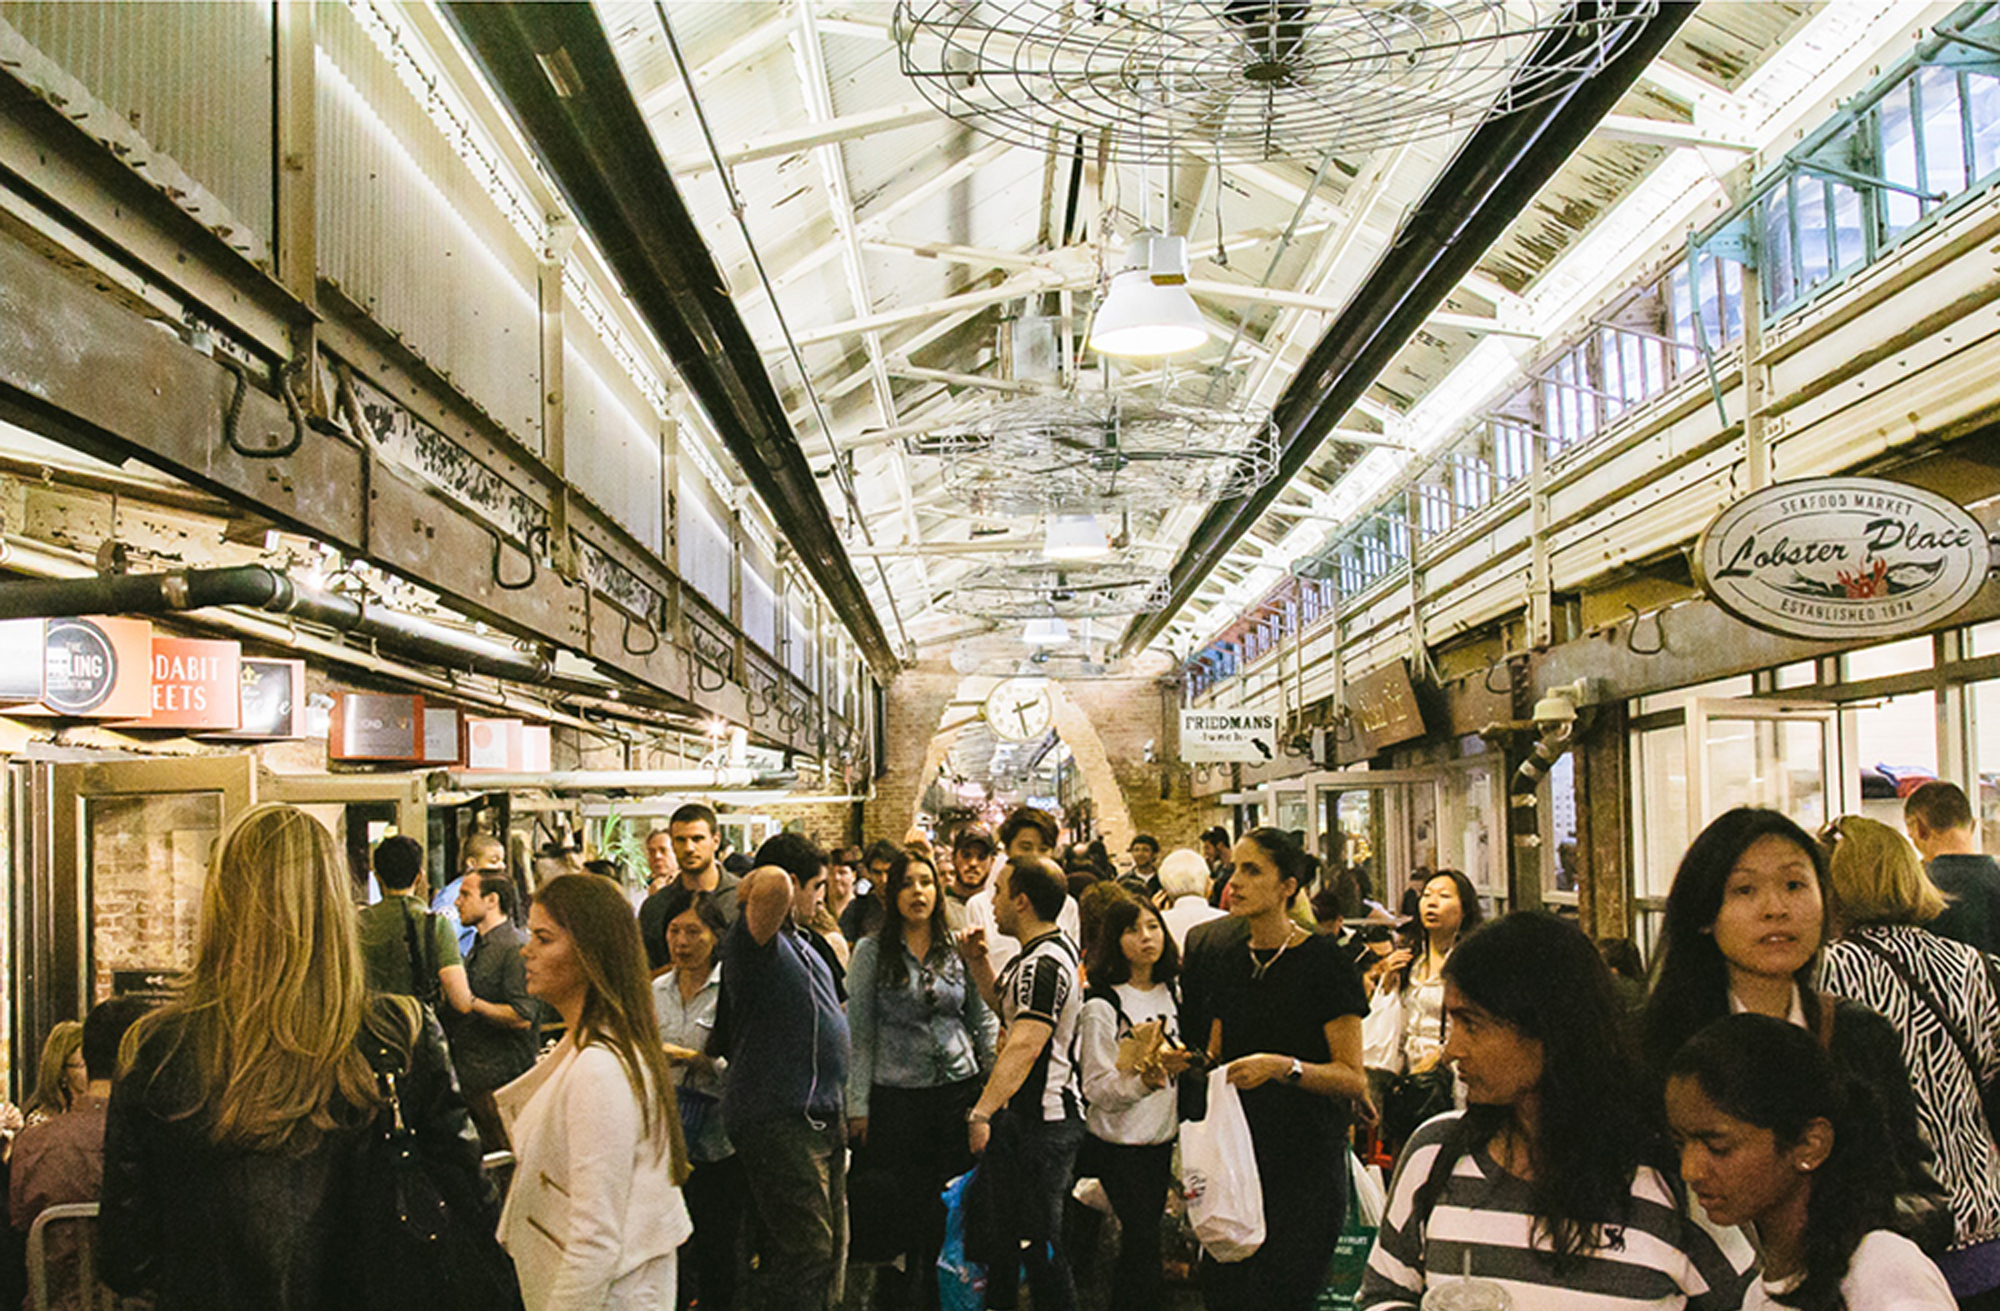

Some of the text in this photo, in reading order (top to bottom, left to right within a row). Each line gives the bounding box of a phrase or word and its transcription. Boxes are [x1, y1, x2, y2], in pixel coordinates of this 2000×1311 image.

[1780, 495, 1913, 516] SEAFOOD MARKET
[1714, 518, 1973, 579] Lobster Place
[1781, 600, 1876, 621] ESTABLISHED
[68, 655, 103, 678] LING
[1185, 716, 1273, 730] FRIEDMANS
[1202, 732, 1242, 742] lunch
